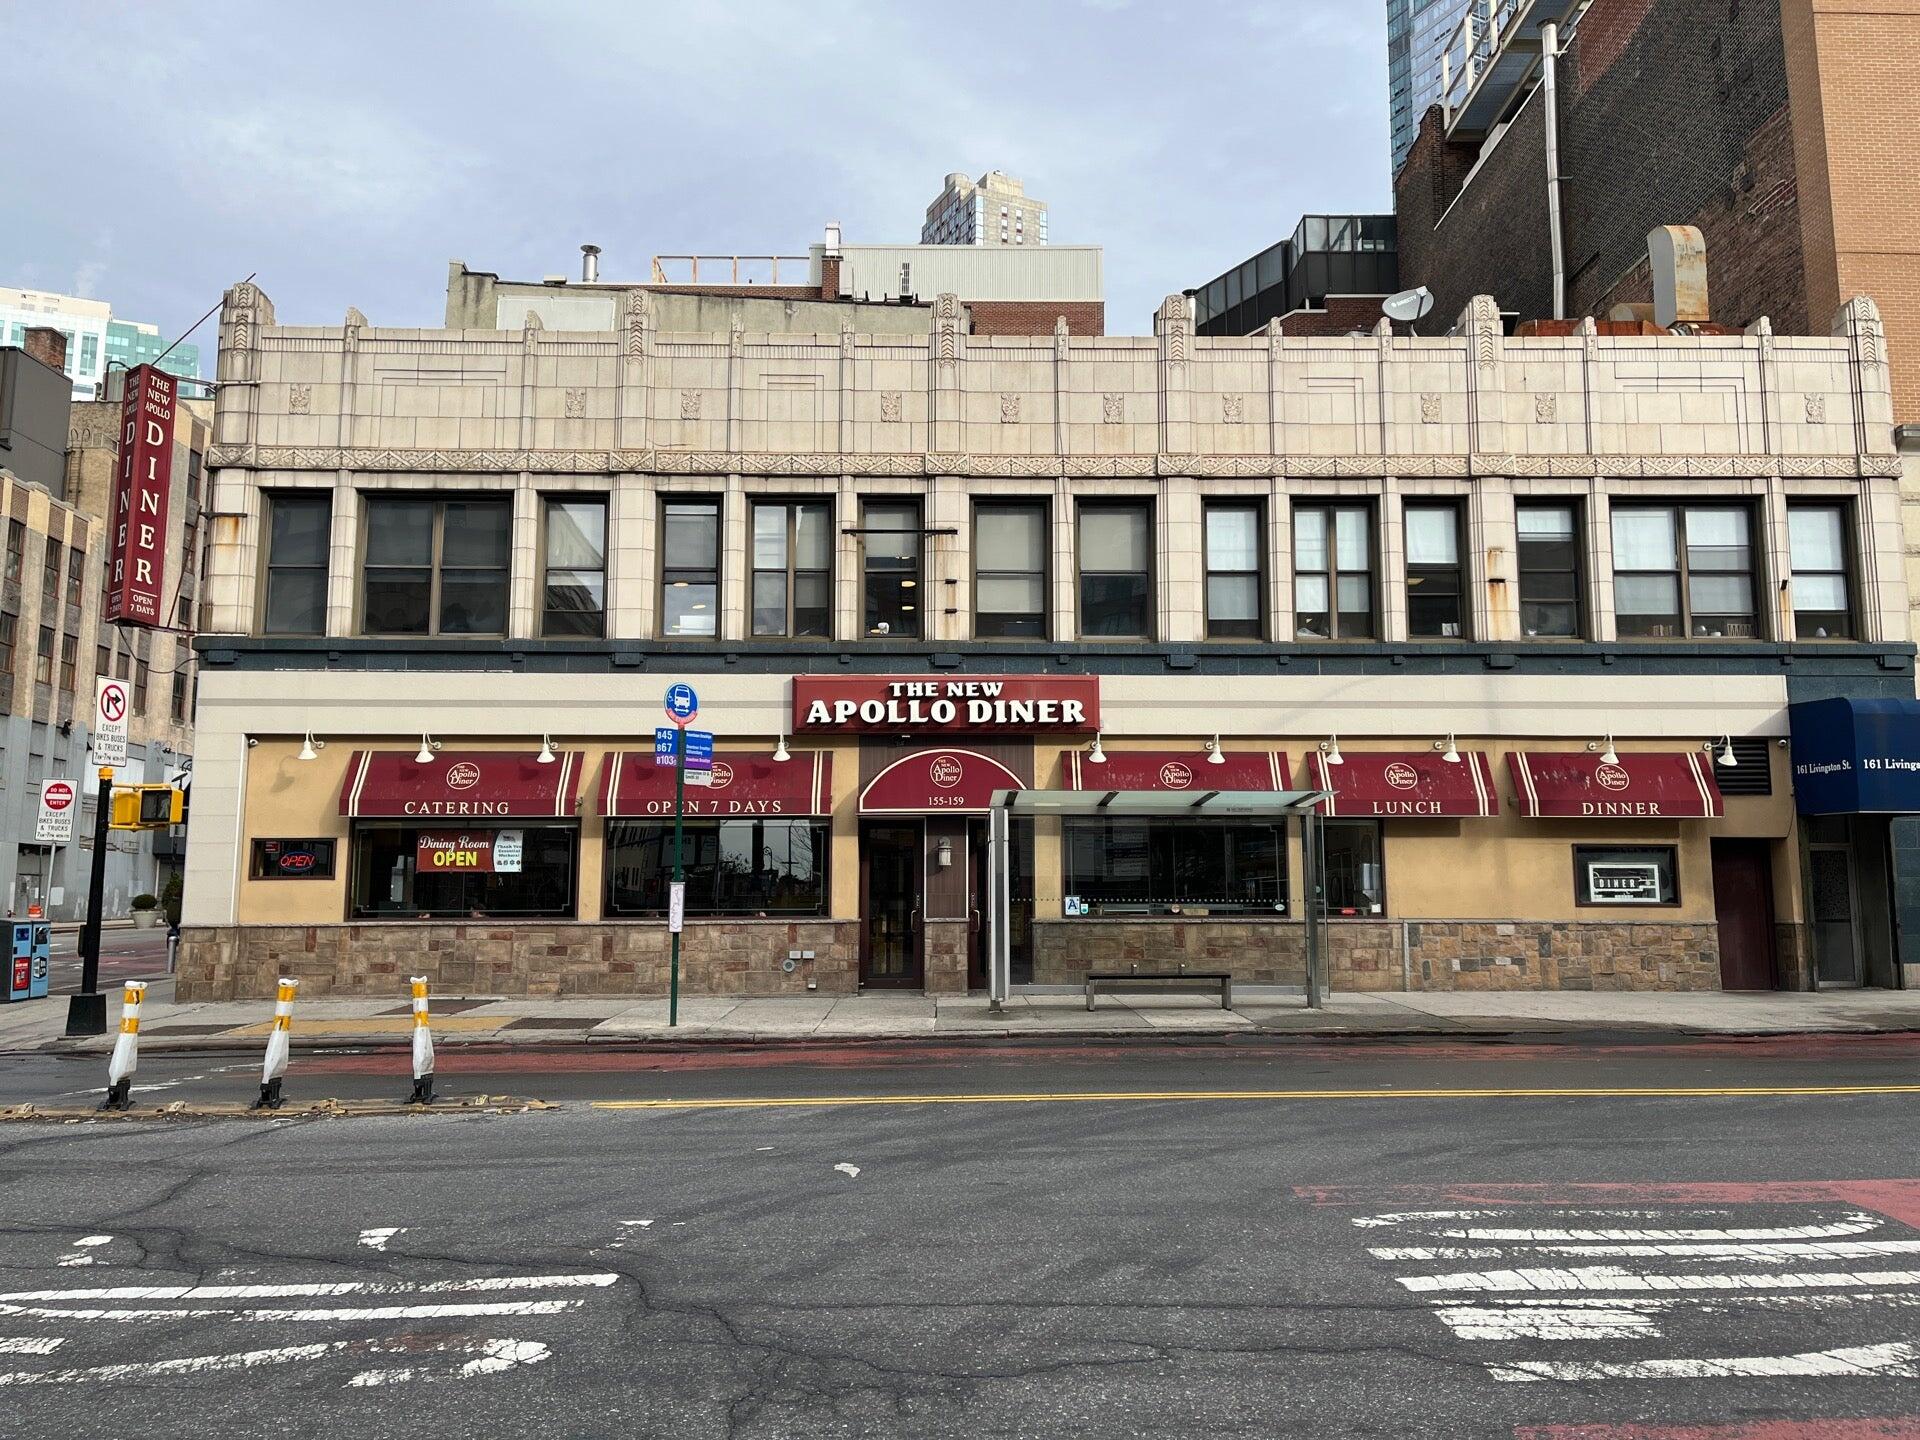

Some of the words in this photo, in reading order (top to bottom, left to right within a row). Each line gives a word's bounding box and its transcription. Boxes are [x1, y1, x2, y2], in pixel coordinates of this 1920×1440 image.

[150, 375, 170, 392] THE
[148, 388, 170, 406] NEW
[145, 402, 170, 420] APOLLO
[114, 422, 136, 582] DINER
[135, 420, 164, 584] DINER
[133, 594, 152, 605] OPEN
[136, 604, 154, 616] DAYS
[889, 682, 938, 697] THE
[947, 682, 1003, 697] NEW
[806, 700, 956, 723] APOLLO
[968, 700, 1086, 723] DINER
[102, 724, 121, 733] EXCEPT
[96, 733, 109, 741] BIKES
[111, 734, 126, 743] BUSES
[657, 731, 672, 740] B45
[104, 744, 124, 752] TRUCKS
[657, 743, 672, 752] B67
[933, 764, 960, 774] Apollo
[1797, 764, 1808, 774] 161
[1809, 763, 1841, 774] Livingston
[1842, 760, 1851, 770] St.
[1863, 759, 1881, 769] 161
[450, 770, 477, 779] Apollo
[935, 773, 957, 781] Diner
[1163, 769, 1190, 778] Apollo
[1388, 770, 1414, 779] Apollo
[1600, 771, 1626, 780] Apollo
[929, 796, 964, 805] 155-159
[404, 801, 509, 814] CATERING
[711, 801, 718, 813] 7
[729, 801, 781, 813] DAYS
[1373, 801, 1442, 814] LUNCH
[1582, 802, 1661, 815] DINNER
[420, 836, 455, 854] Dining
[458, 836, 489, 848] Room
[280, 856, 314, 866] OPEN
[433, 851, 478, 866] OPEN
[1600, 879, 1635, 888] DINER
[1068, 899, 1077, 909] A
